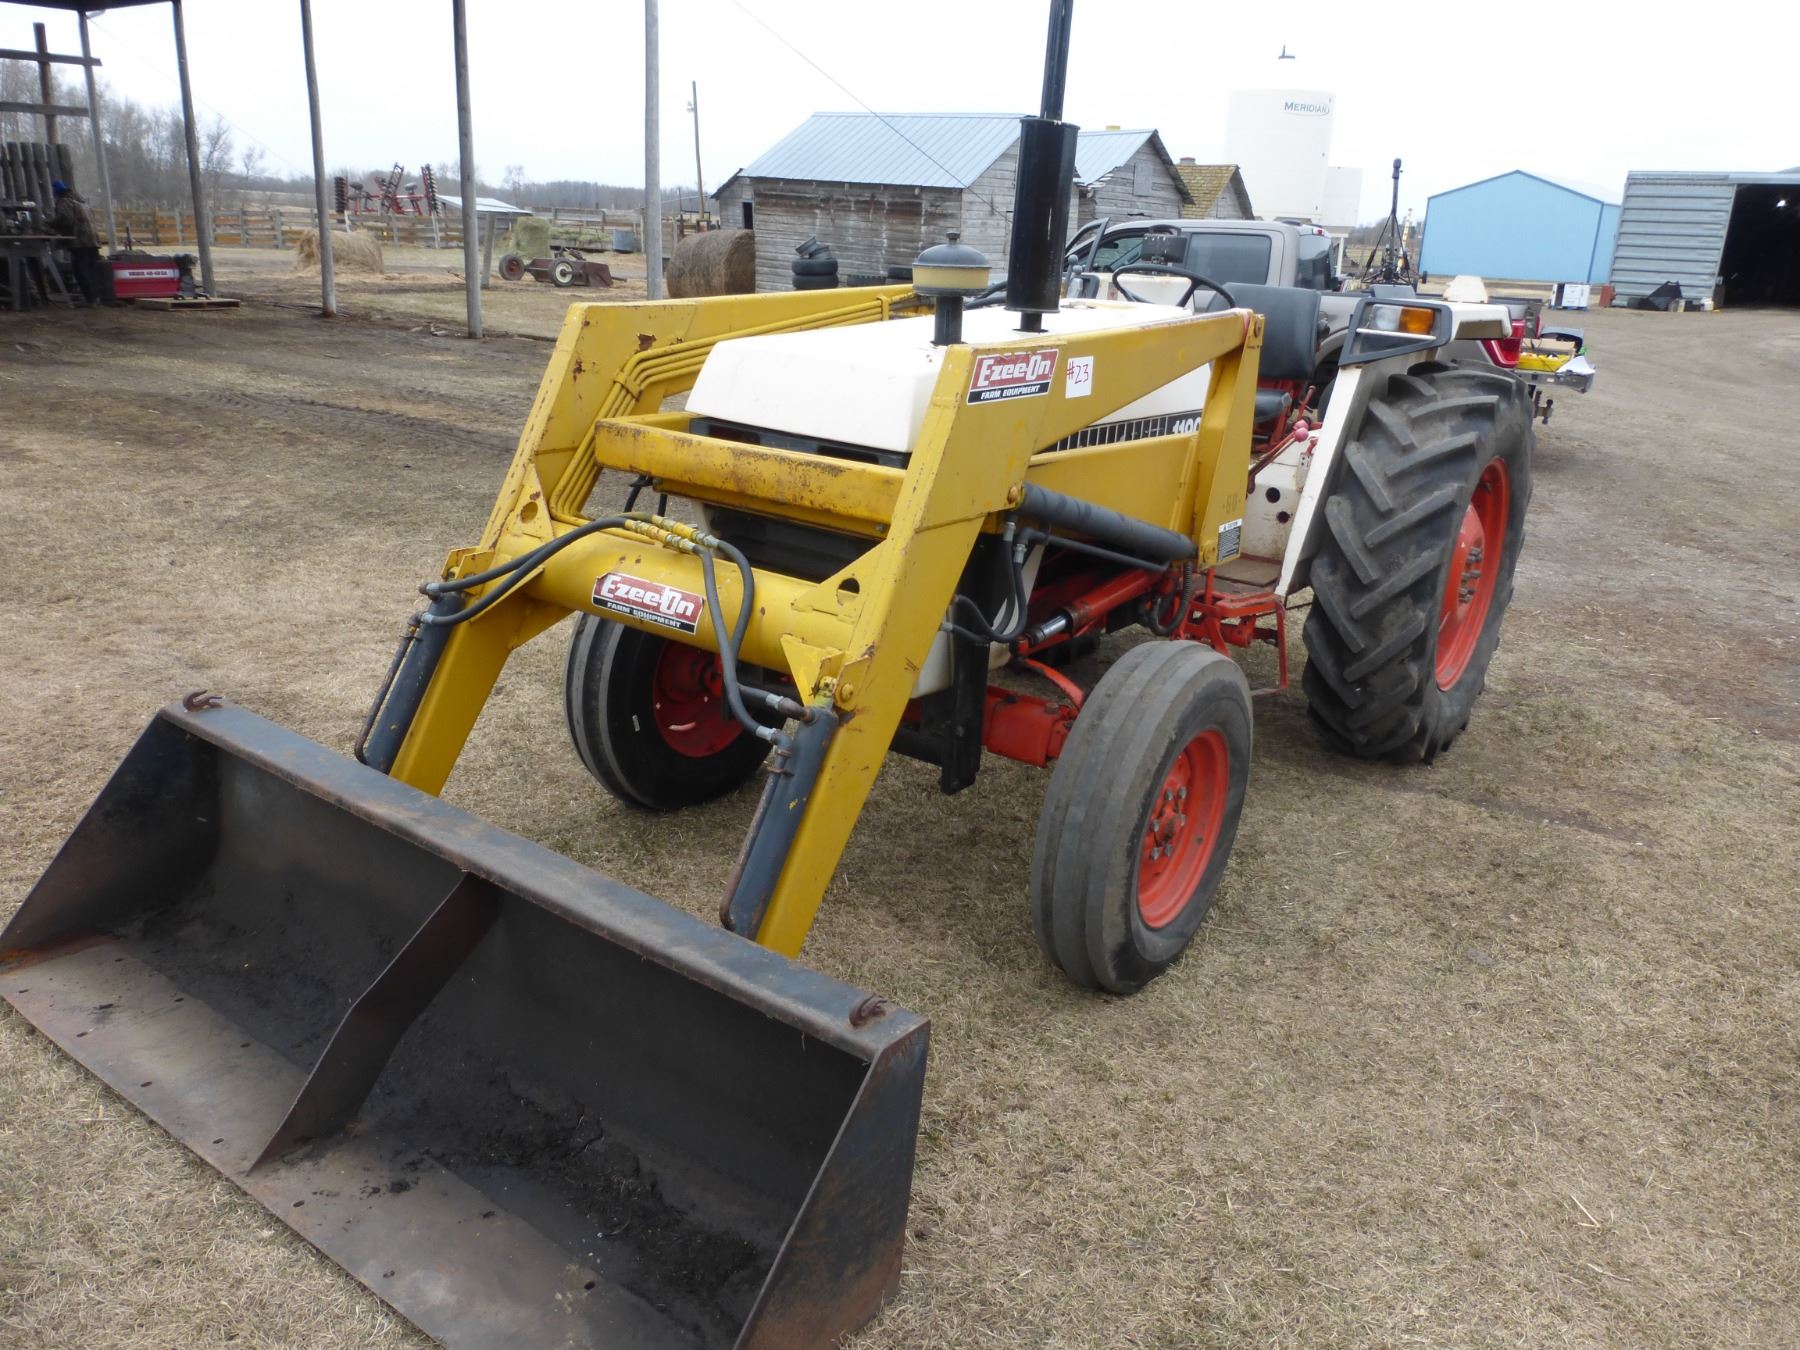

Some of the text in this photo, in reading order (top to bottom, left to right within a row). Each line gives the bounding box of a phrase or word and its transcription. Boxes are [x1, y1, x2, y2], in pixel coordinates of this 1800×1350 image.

[1066, 361, 1089, 384] #23
[980, 385, 1040, 400] FARM EQUIPMENT
[607, 602, 681, 628] FARM EQUIPMENT
